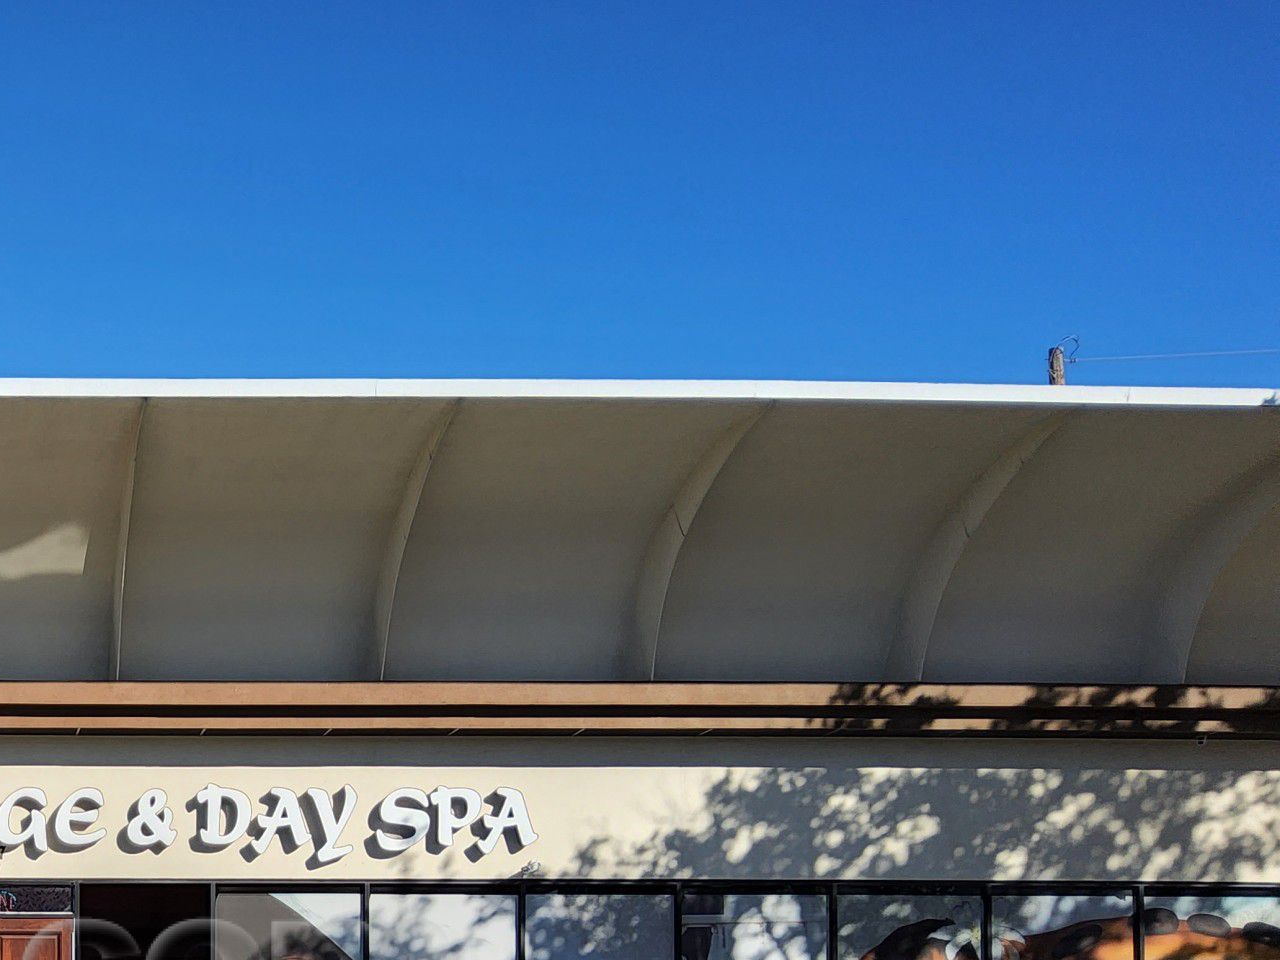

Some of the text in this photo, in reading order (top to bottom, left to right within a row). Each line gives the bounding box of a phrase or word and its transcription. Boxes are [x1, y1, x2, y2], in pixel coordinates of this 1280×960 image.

[117, 787, 178, 854] &
[186, 782, 359, 870] DAY
[364, 784, 538, 863] SPA
